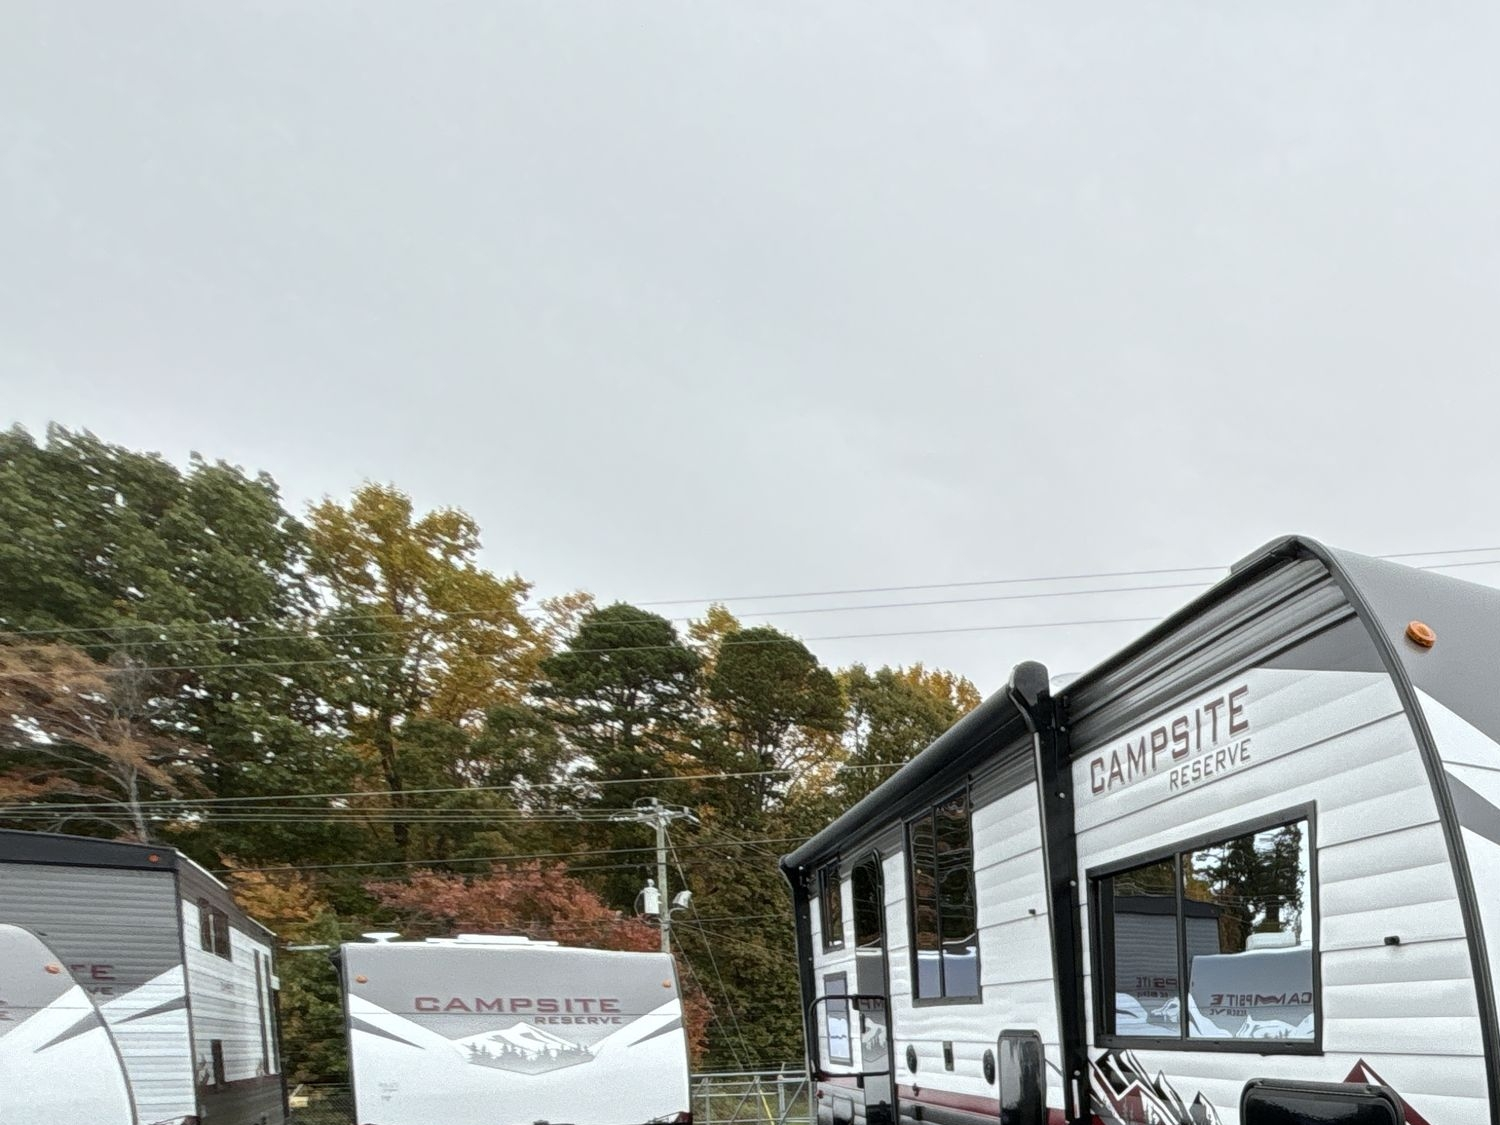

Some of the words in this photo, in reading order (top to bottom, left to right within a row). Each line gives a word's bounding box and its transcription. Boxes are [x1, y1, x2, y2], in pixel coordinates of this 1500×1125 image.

[1090, 684, 1250, 795] CAMPSITE
[1169, 738, 1251, 791] RESERVE
[415, 997, 622, 1013] CAMPSITE
[534, 1016, 622, 1025] RESERVE
